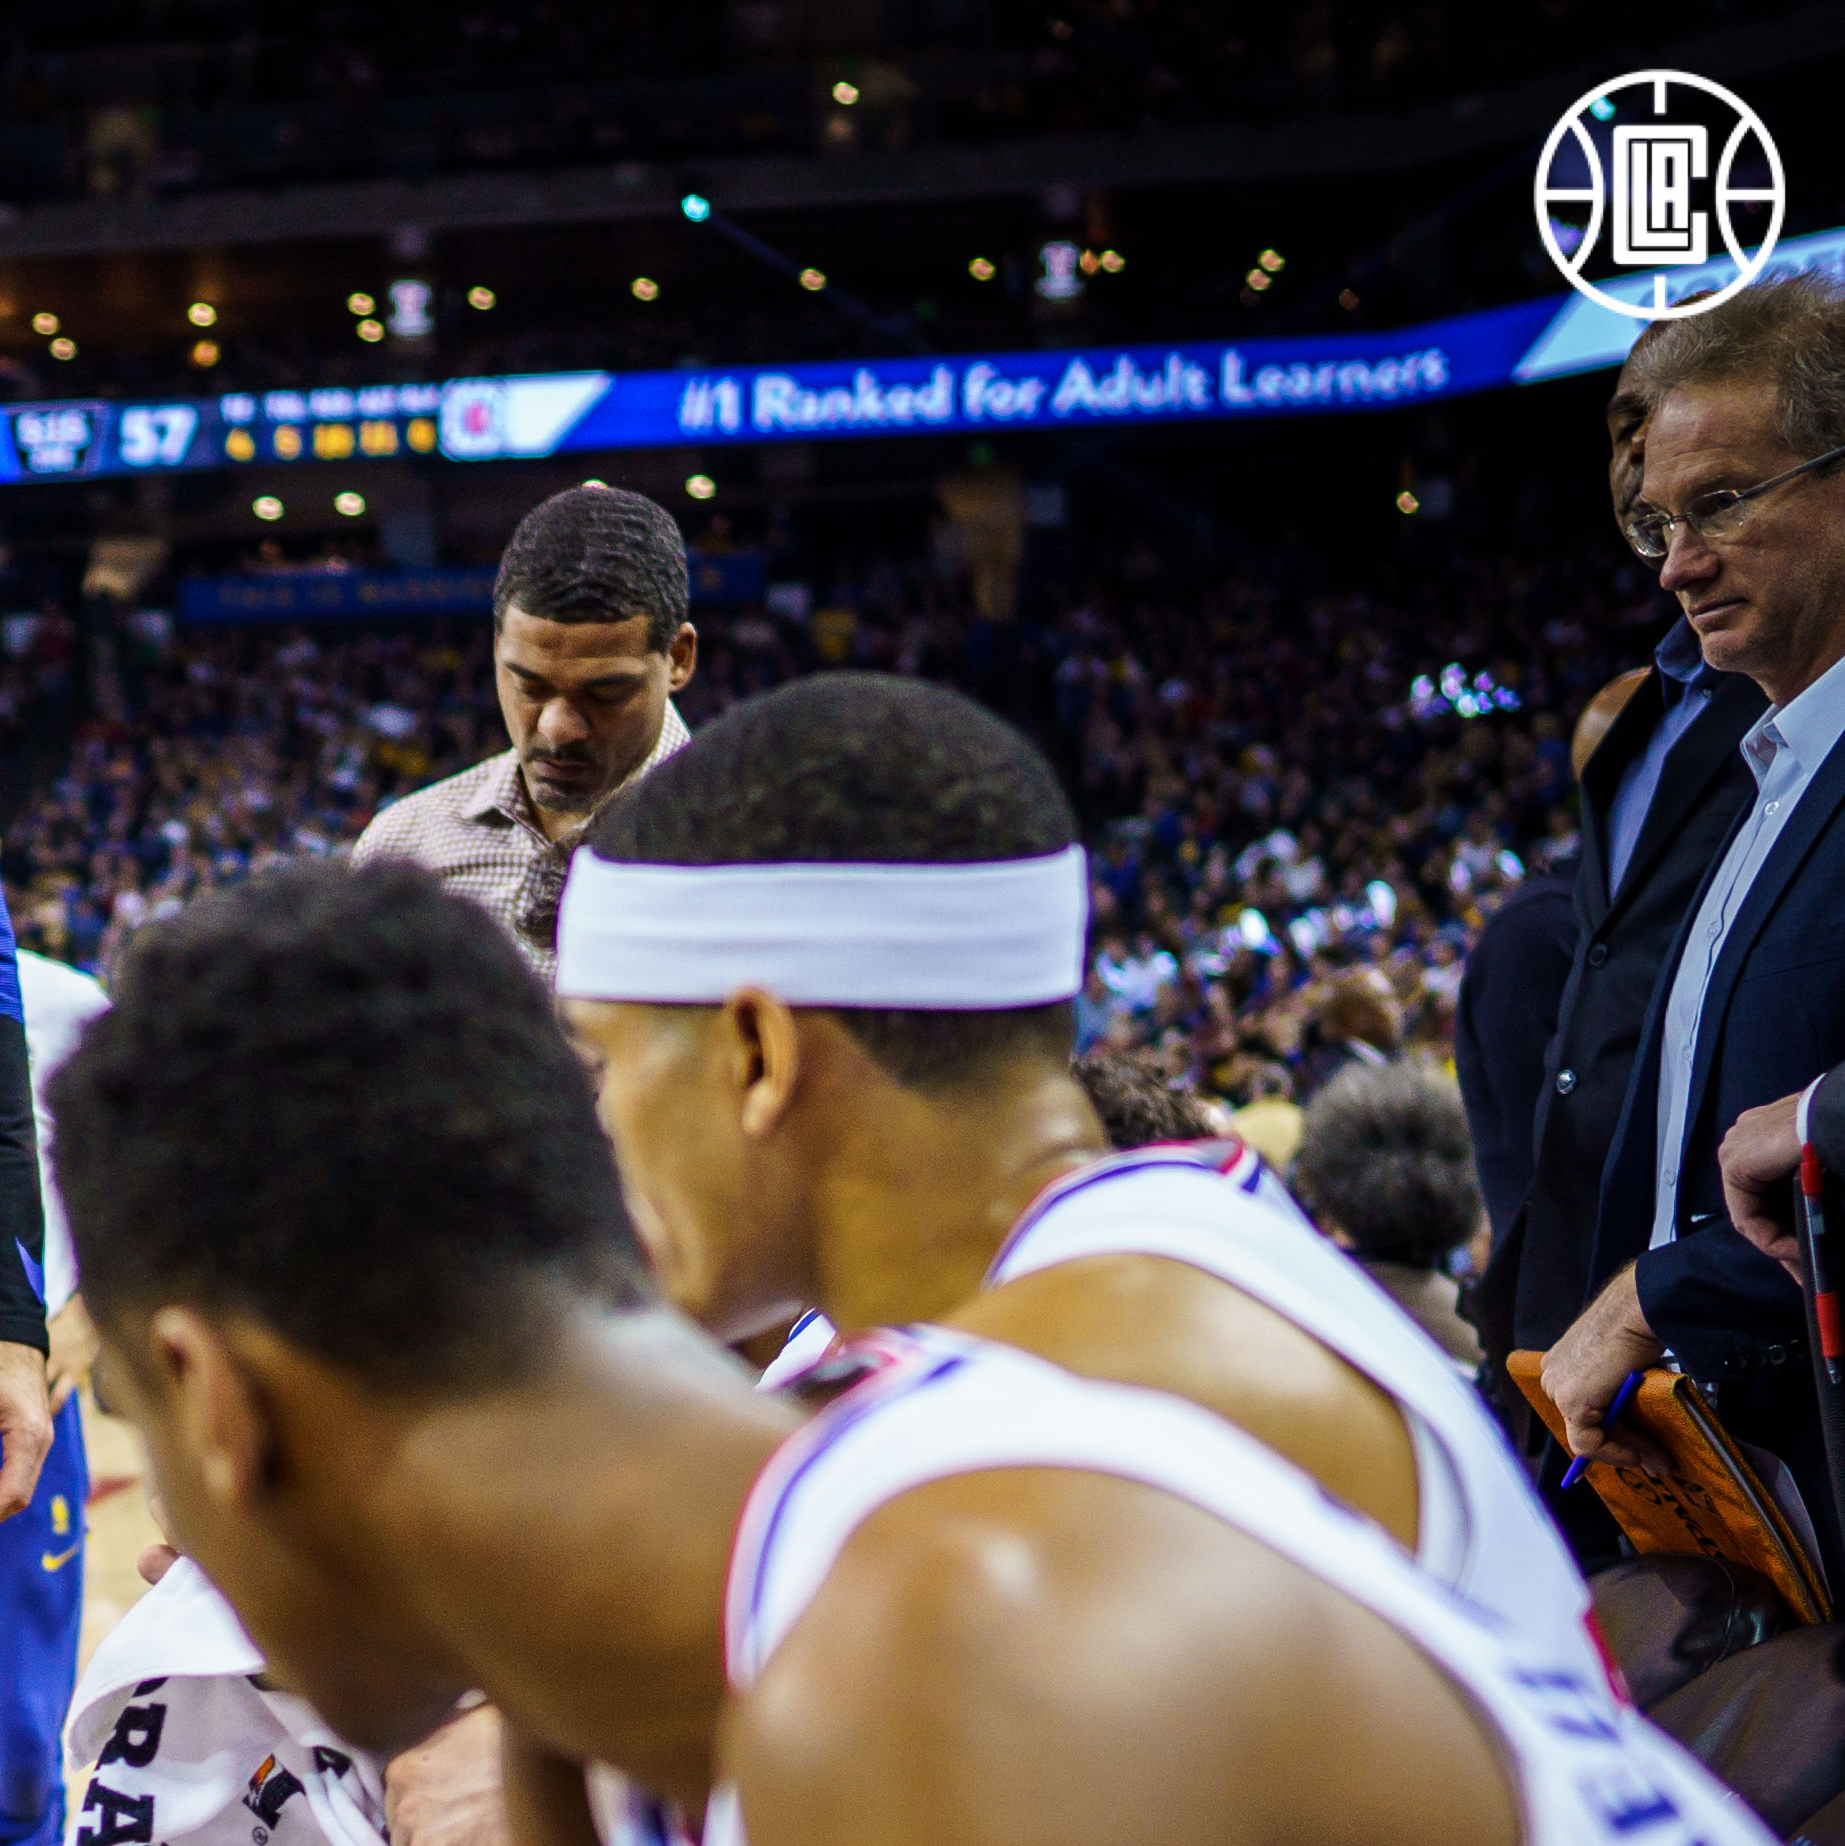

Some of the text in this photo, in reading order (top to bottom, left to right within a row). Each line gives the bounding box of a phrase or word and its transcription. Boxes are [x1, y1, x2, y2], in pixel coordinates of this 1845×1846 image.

[754, 364, 954, 432] Ranked
[964, 362, 1047, 420] for
[1052, 352, 1212, 416] Adult
[1221, 347, 1450, 408] Learners
[120, 405, 197, 466] 57
